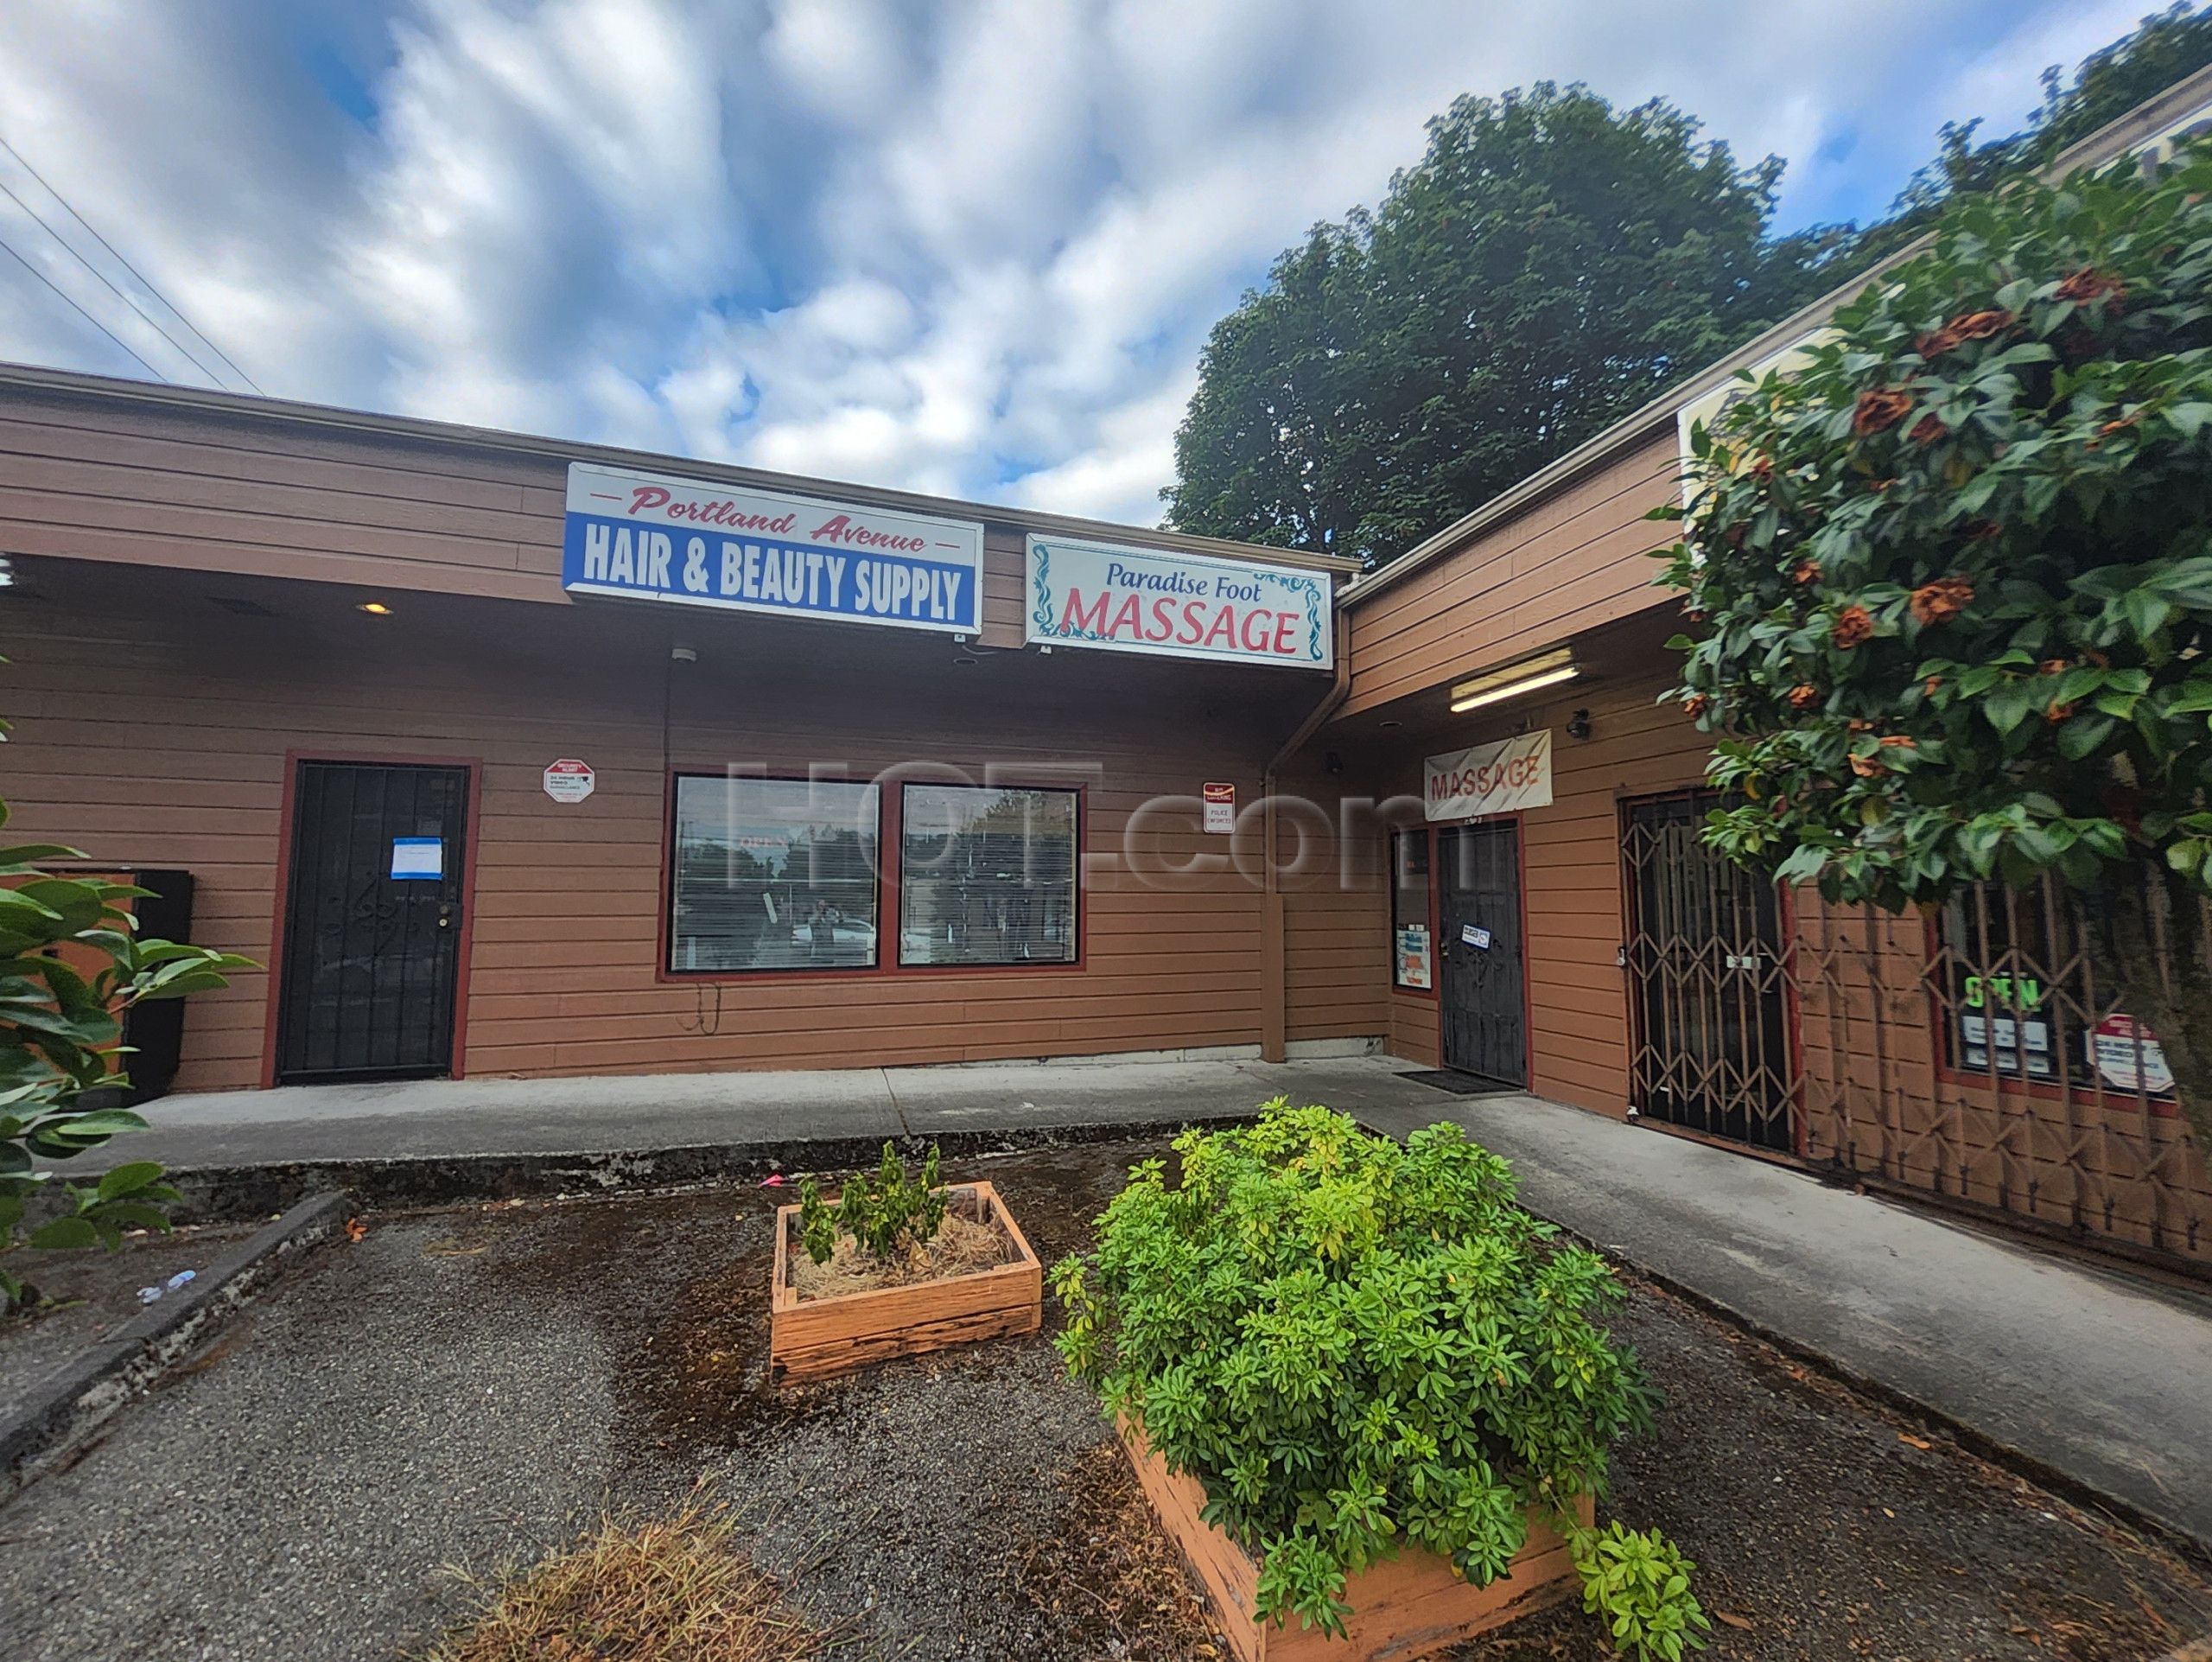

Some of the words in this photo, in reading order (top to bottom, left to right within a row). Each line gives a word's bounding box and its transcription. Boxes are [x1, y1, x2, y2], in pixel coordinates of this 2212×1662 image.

[627, 486, 796, 535] Portland
[810, 514, 928, 553] Avenue
[583, 523, 671, 589] HAIR
[683, 537, 709, 593] &
[720, 541, 847, 608] BEAUTY
[855, 559, 962, 621] SUPPLY
[1106, 563, 1208, 596] Paradise
[1215, 576, 1262, 602] Foot
[1059, 587, 1300, 654] MASSAGE
[1431, 755, 1541, 801] MASSAGE
